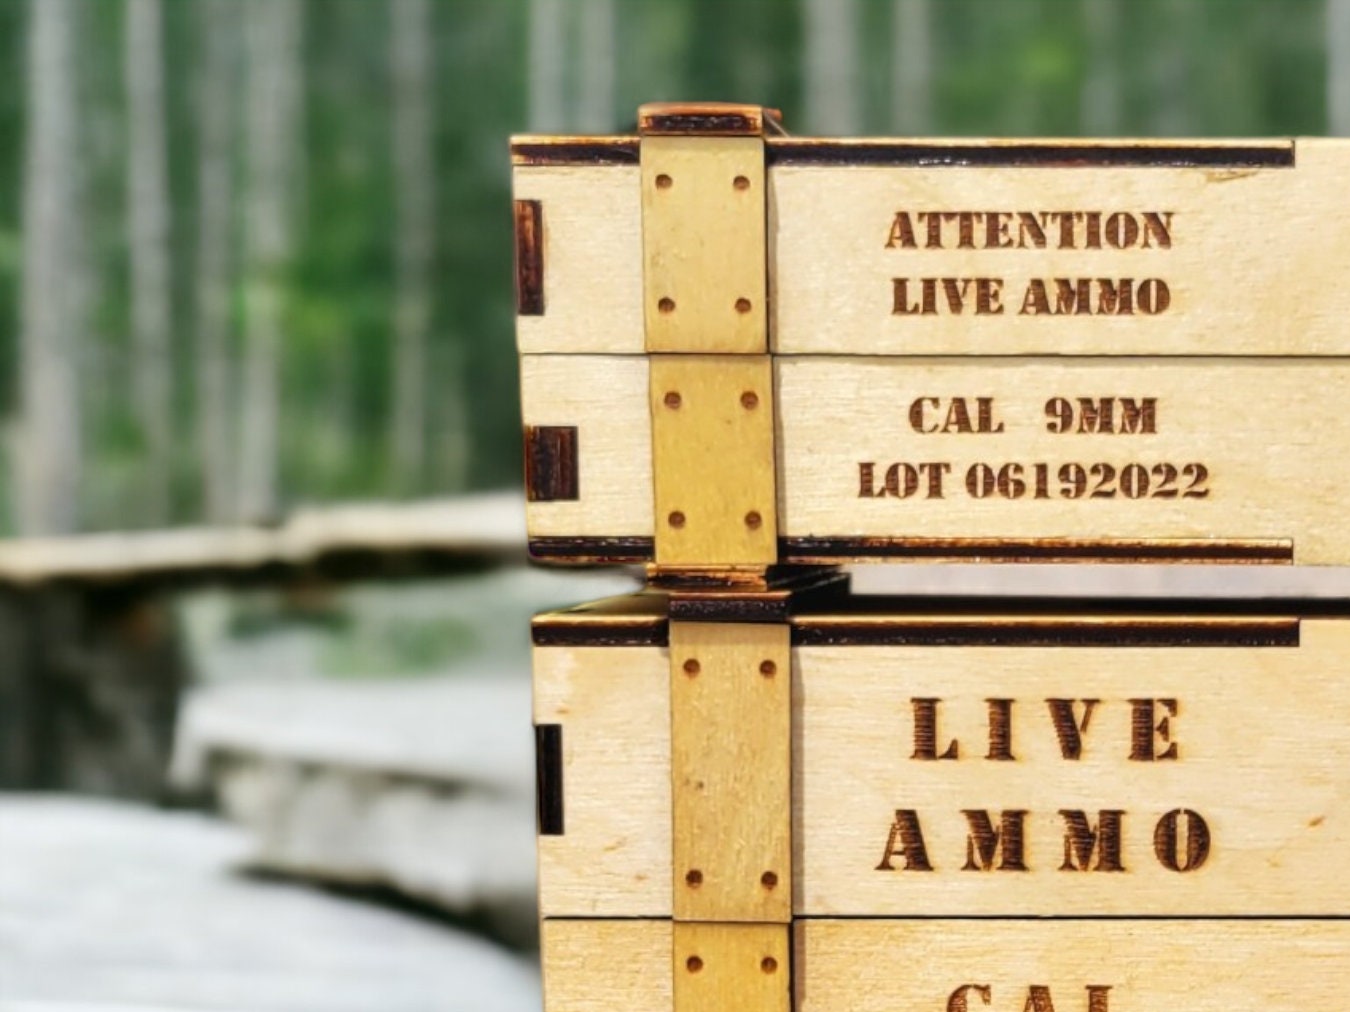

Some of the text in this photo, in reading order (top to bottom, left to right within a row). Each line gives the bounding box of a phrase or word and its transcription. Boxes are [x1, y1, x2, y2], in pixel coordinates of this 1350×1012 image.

[884, 211, 1176, 249] ATTENTION
[891, 278, 1170, 315] LIVE AMMO
[909, 397, 1158, 434] CAL 9MM
[858, 462, 1209, 499] LOT 06192022
[909, 697, 1179, 761] LIVE
[874, 808, 1212, 872] AMMO
